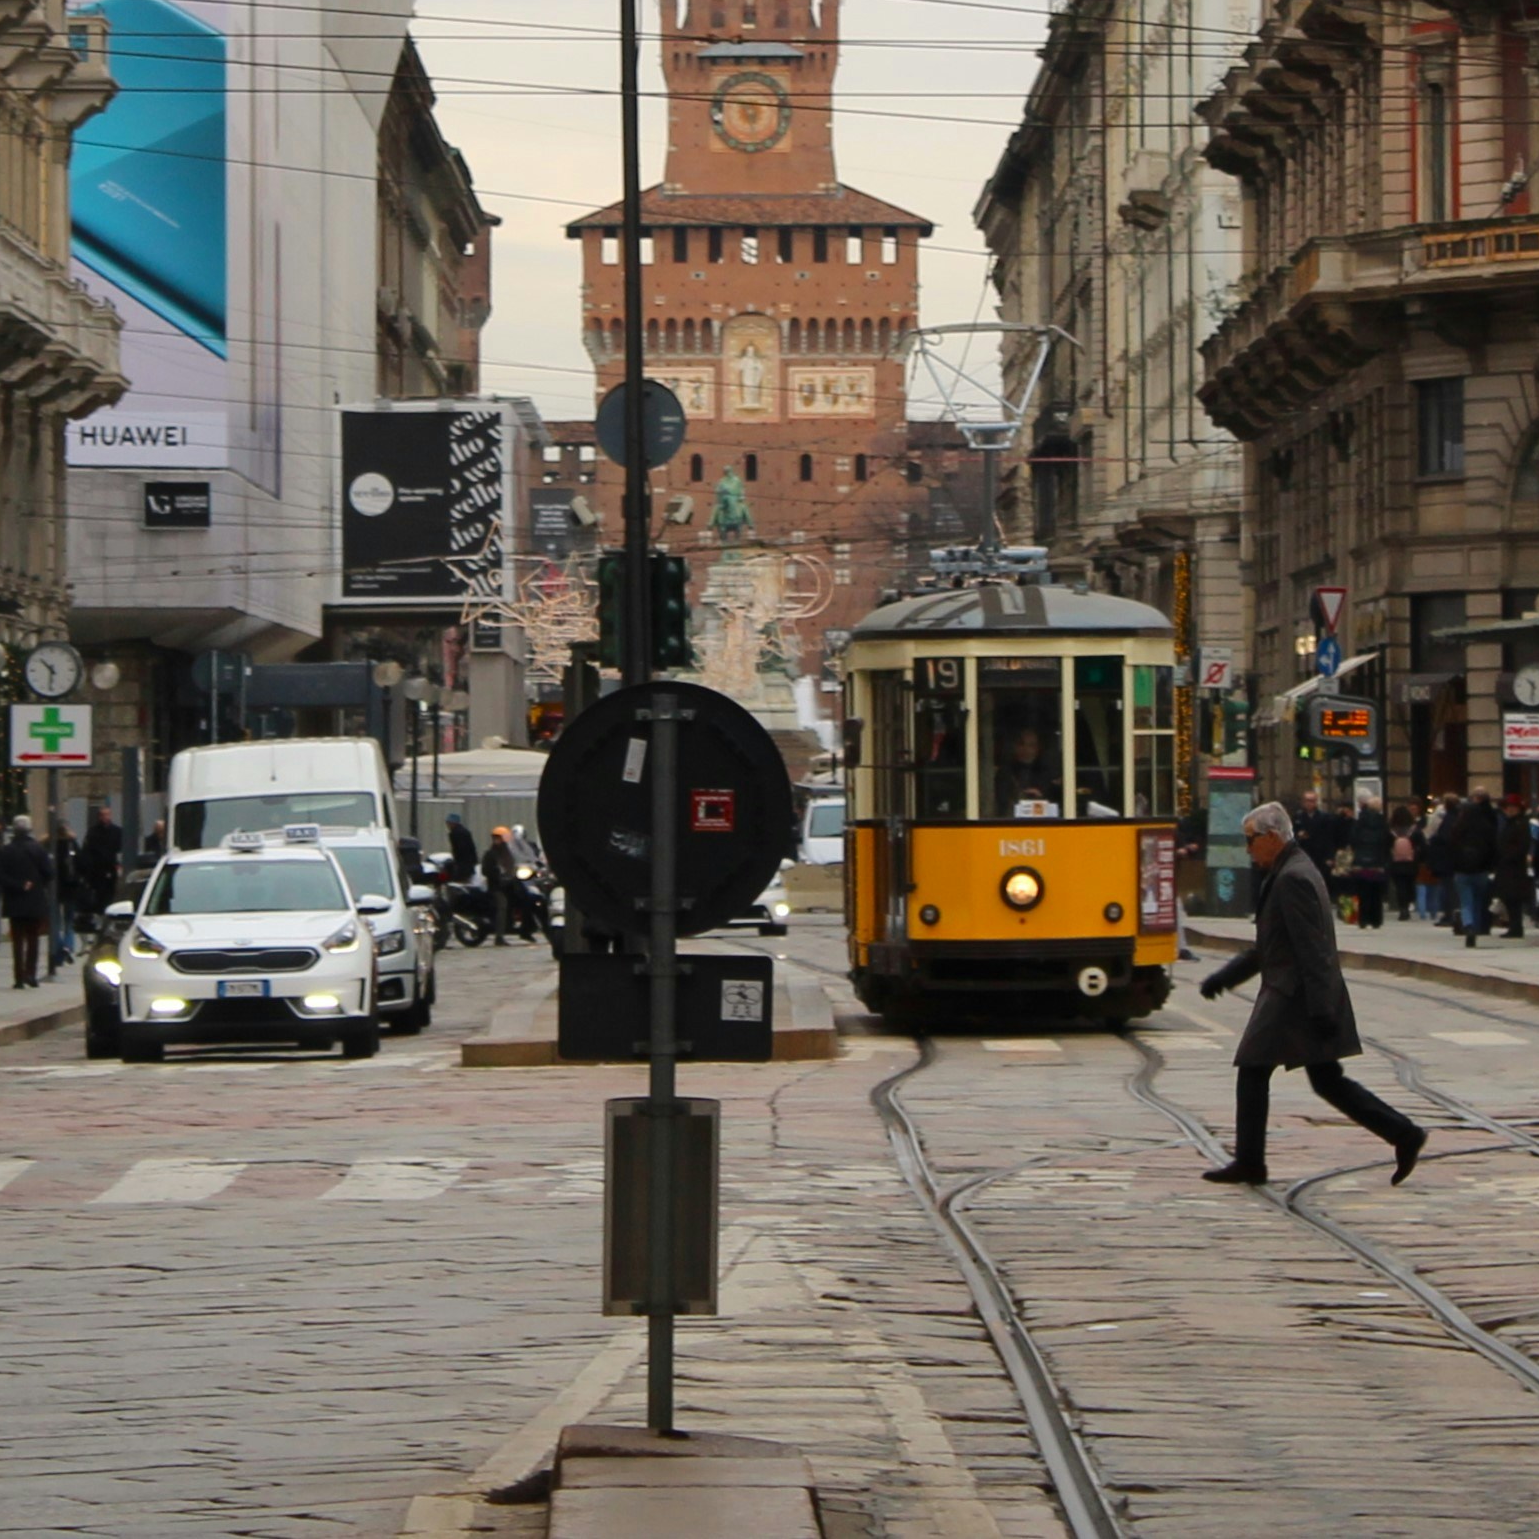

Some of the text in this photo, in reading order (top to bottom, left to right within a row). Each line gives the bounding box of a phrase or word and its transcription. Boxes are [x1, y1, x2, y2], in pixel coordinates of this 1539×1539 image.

[79, 426, 187, 447] HUAWEI
[926, 659, 958, 689] 19
[999, 839, 1045, 857] 1861
